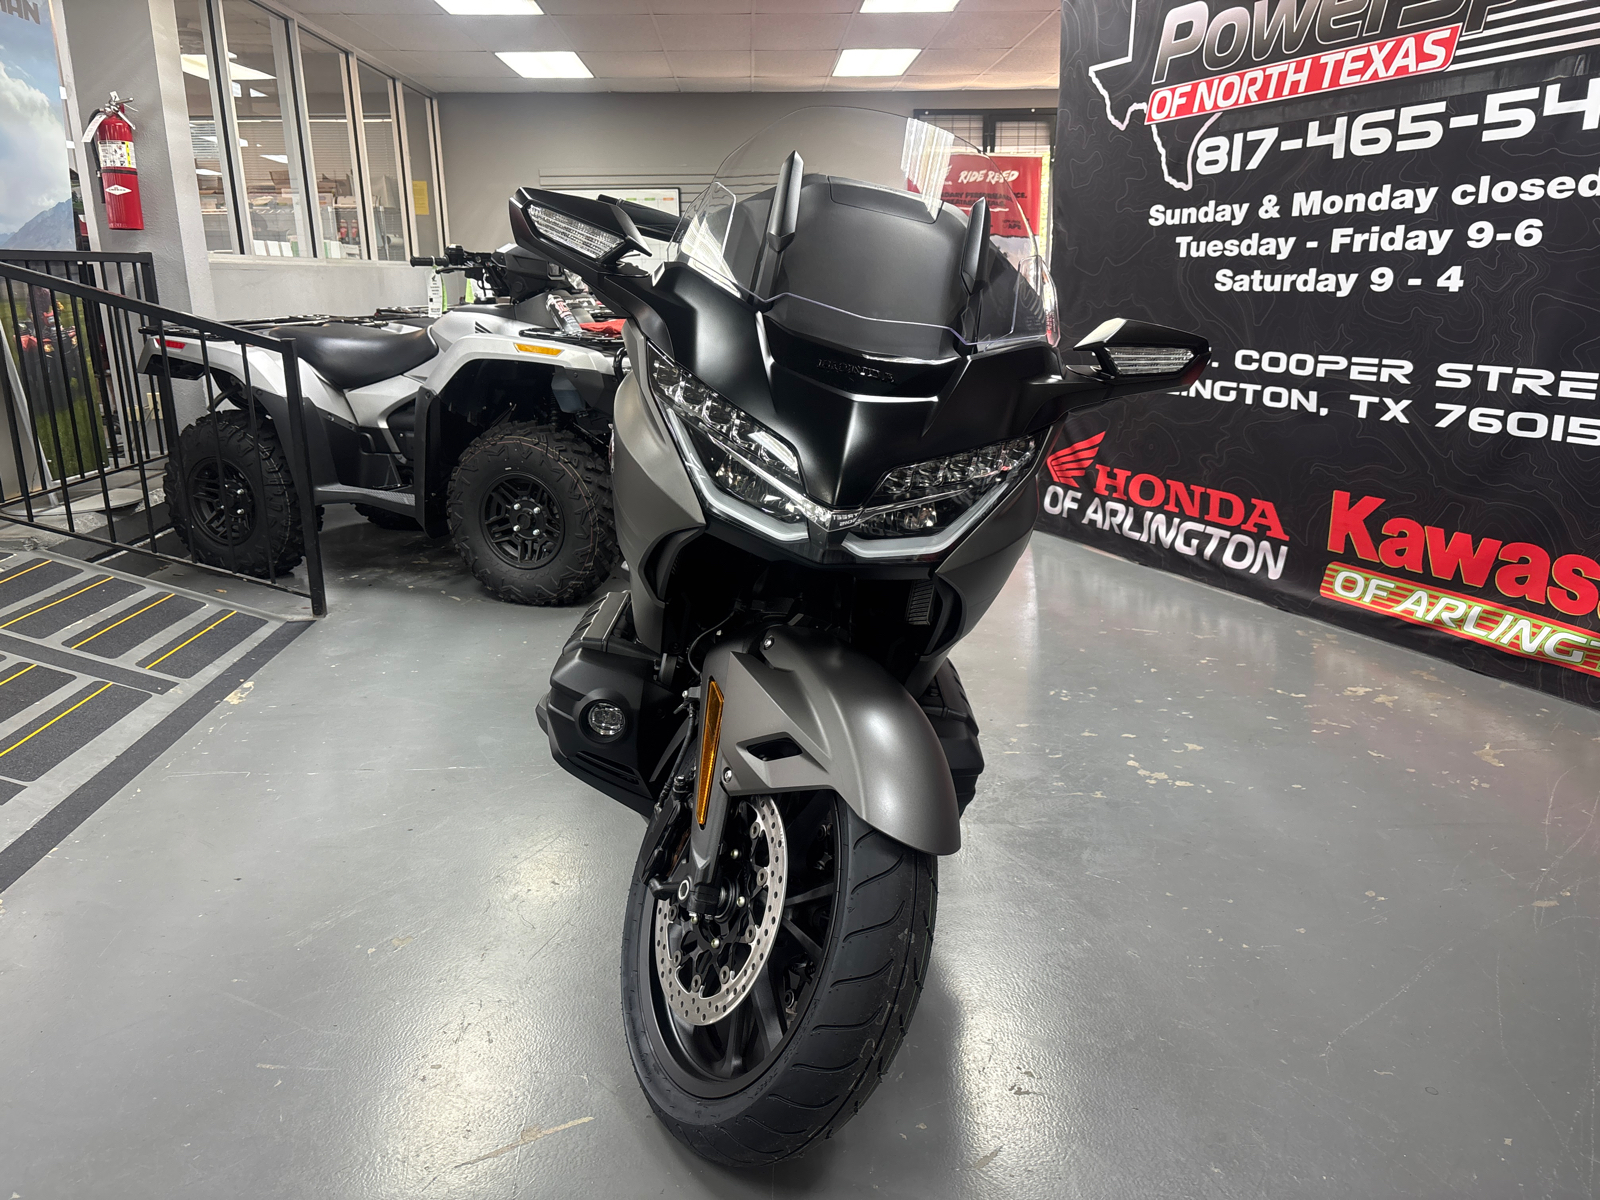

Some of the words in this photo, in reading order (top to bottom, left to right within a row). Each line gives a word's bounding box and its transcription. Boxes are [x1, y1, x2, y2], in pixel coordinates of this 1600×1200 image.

[1150, 84, 1192, 120] OF
[1192, 59, 1313, 113] NORTH
[1319, 28, 1452, 89] TEXAS
[957, 169, 987, 185] RIDE
[1148, 200, 1250, 226] Sunday
[1258, 194, 1281, 220] &
[1291, 183, 1439, 217] Monday
[1451, 167, 1600, 206] closed
[1175, 233, 1297, 260] Tuesday
[1330, 224, 1454, 256] Friday
[1466, 218, 1544, 249] 9-6
[1214, 268, 1359, 297] Saturday
[1369, 266, 1395, 293] 9
[1436, 265, 1465, 293] 4
[1234, 349, 1414, 385] COOPER
[1166, 378, 1329, 417] NGTON,
[1349, 394, 1413, 424] TX
[1435, 402, 1600, 446] 76015
[1043, 485, 1082, 518] OF
[1081, 497, 1289, 580] ARLINGTON
[1093, 464, 1290, 541] HONDA
[1327, 490, 1600, 616] Kawas
[1333, 570, 1395, 604] OF
[1393, 589, 1600, 664] ARLING
